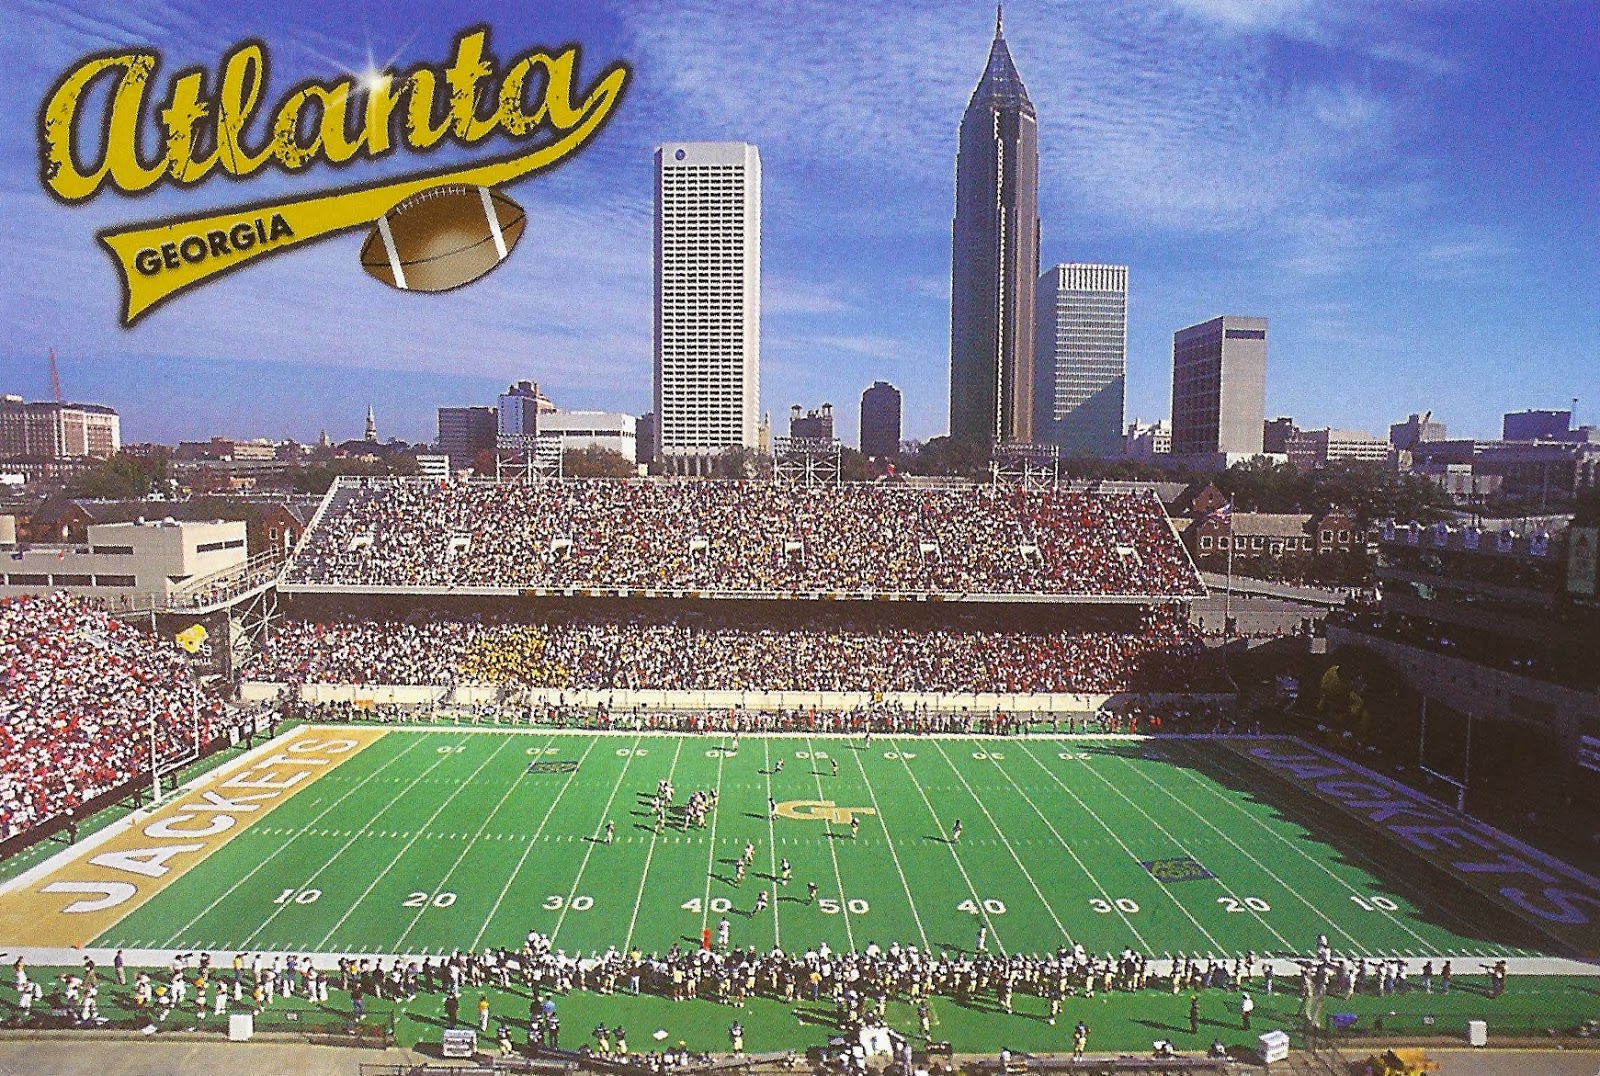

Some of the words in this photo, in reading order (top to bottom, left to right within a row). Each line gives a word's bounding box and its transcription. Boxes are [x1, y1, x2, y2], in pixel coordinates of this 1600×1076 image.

[36, 737, 360, 914] JACKETS
[273, 888, 323, 906] 10
[401, 891, 458, 909] 20
[541, 894, 595, 912] 30
[681, 896, 733, 914] 40
[819, 897, 871, 915] 50
[955, 897, 1008, 914] 40
[1090, 896, 1141, 914] 30
[1216, 896, 1272, 914] 20
[1349, 894, 1400, 912] 10
[1248, 746, 1600, 925] JACKETS
